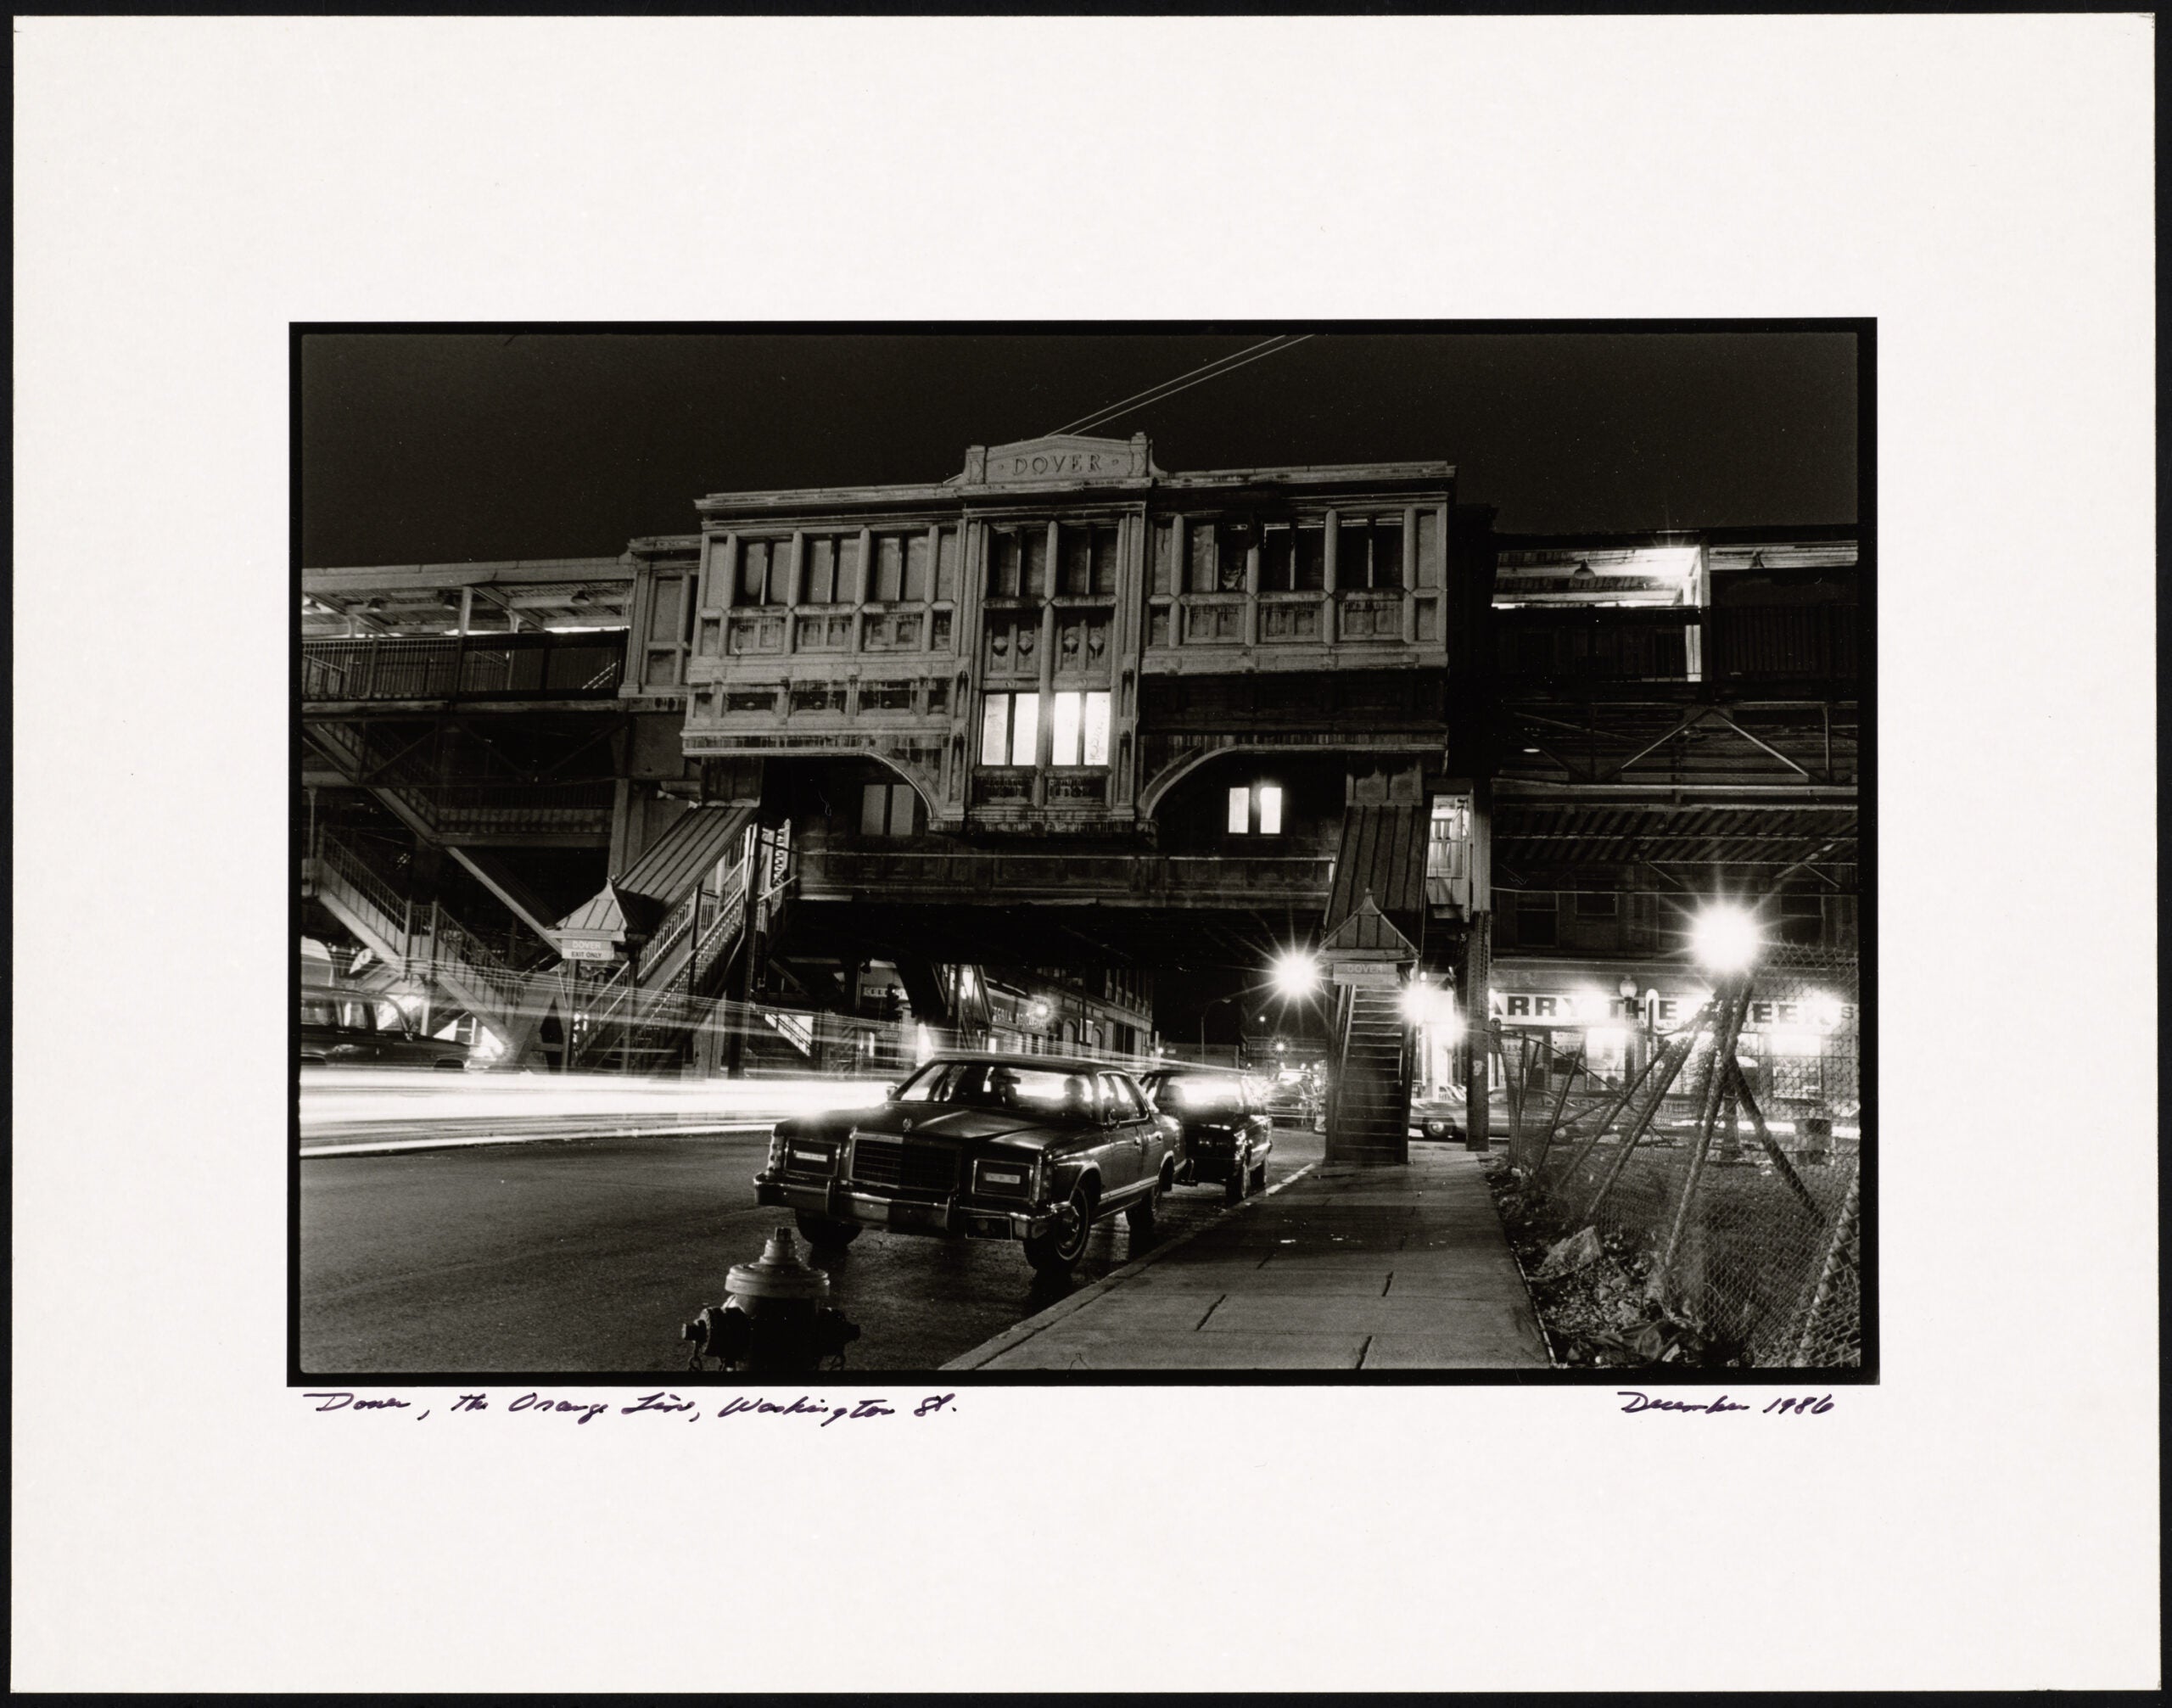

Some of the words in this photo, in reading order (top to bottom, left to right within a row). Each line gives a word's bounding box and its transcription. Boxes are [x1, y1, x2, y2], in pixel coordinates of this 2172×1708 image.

[1013, 453, 1102, 475] DOVER
[572, 940, 602, 949] DOVER
[1347, 963, 1384, 973] DOVER
[509, 1392, 608, 1424] Orange
[718, 1397, 895, 1426] Washington
[1617, 1392, 1749, 1414] December
[1763, 1394, 1834, 1414] 1986
